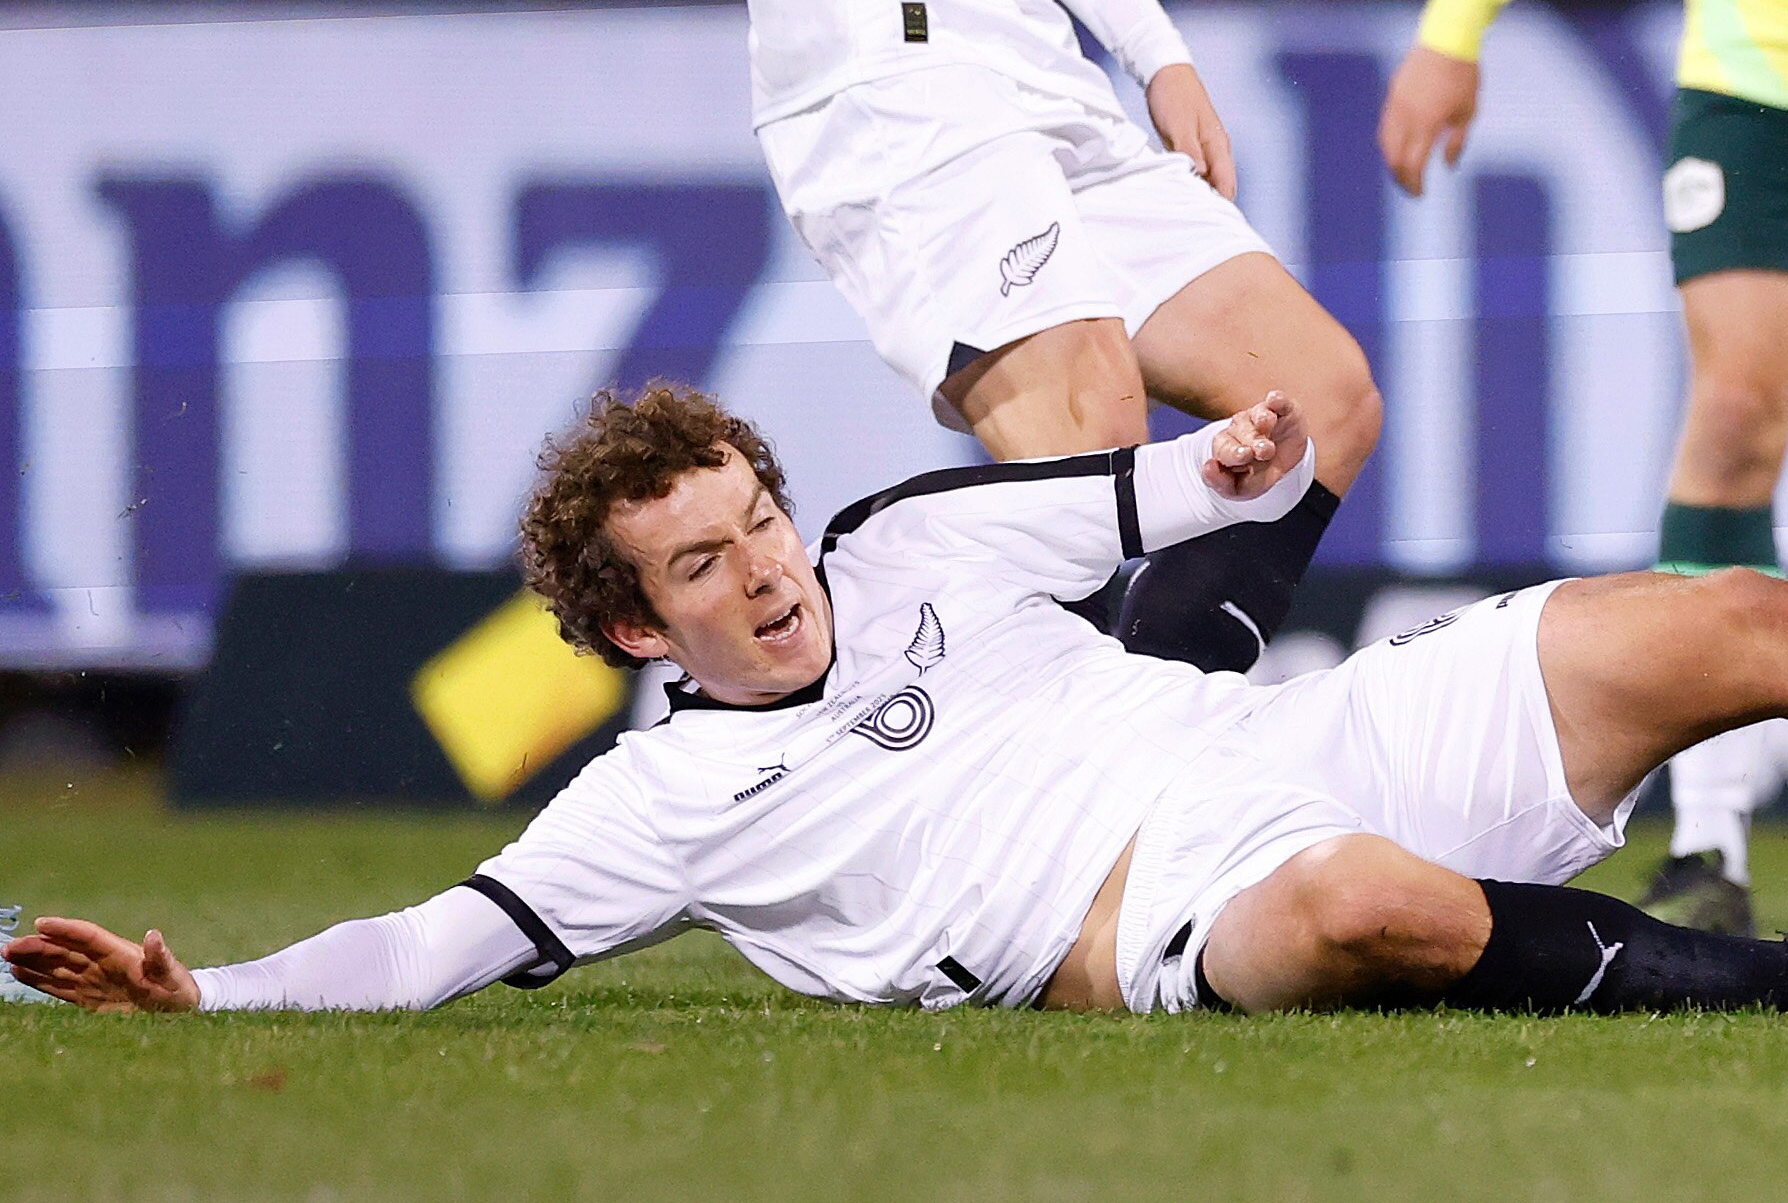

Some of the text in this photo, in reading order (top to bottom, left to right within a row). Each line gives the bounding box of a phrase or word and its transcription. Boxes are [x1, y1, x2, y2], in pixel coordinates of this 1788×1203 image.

[0, 166, 785, 616] nz
[831, 695, 862, 722] AUSTRALIA
[836, 707, 871, 735] SEPTEMBER
